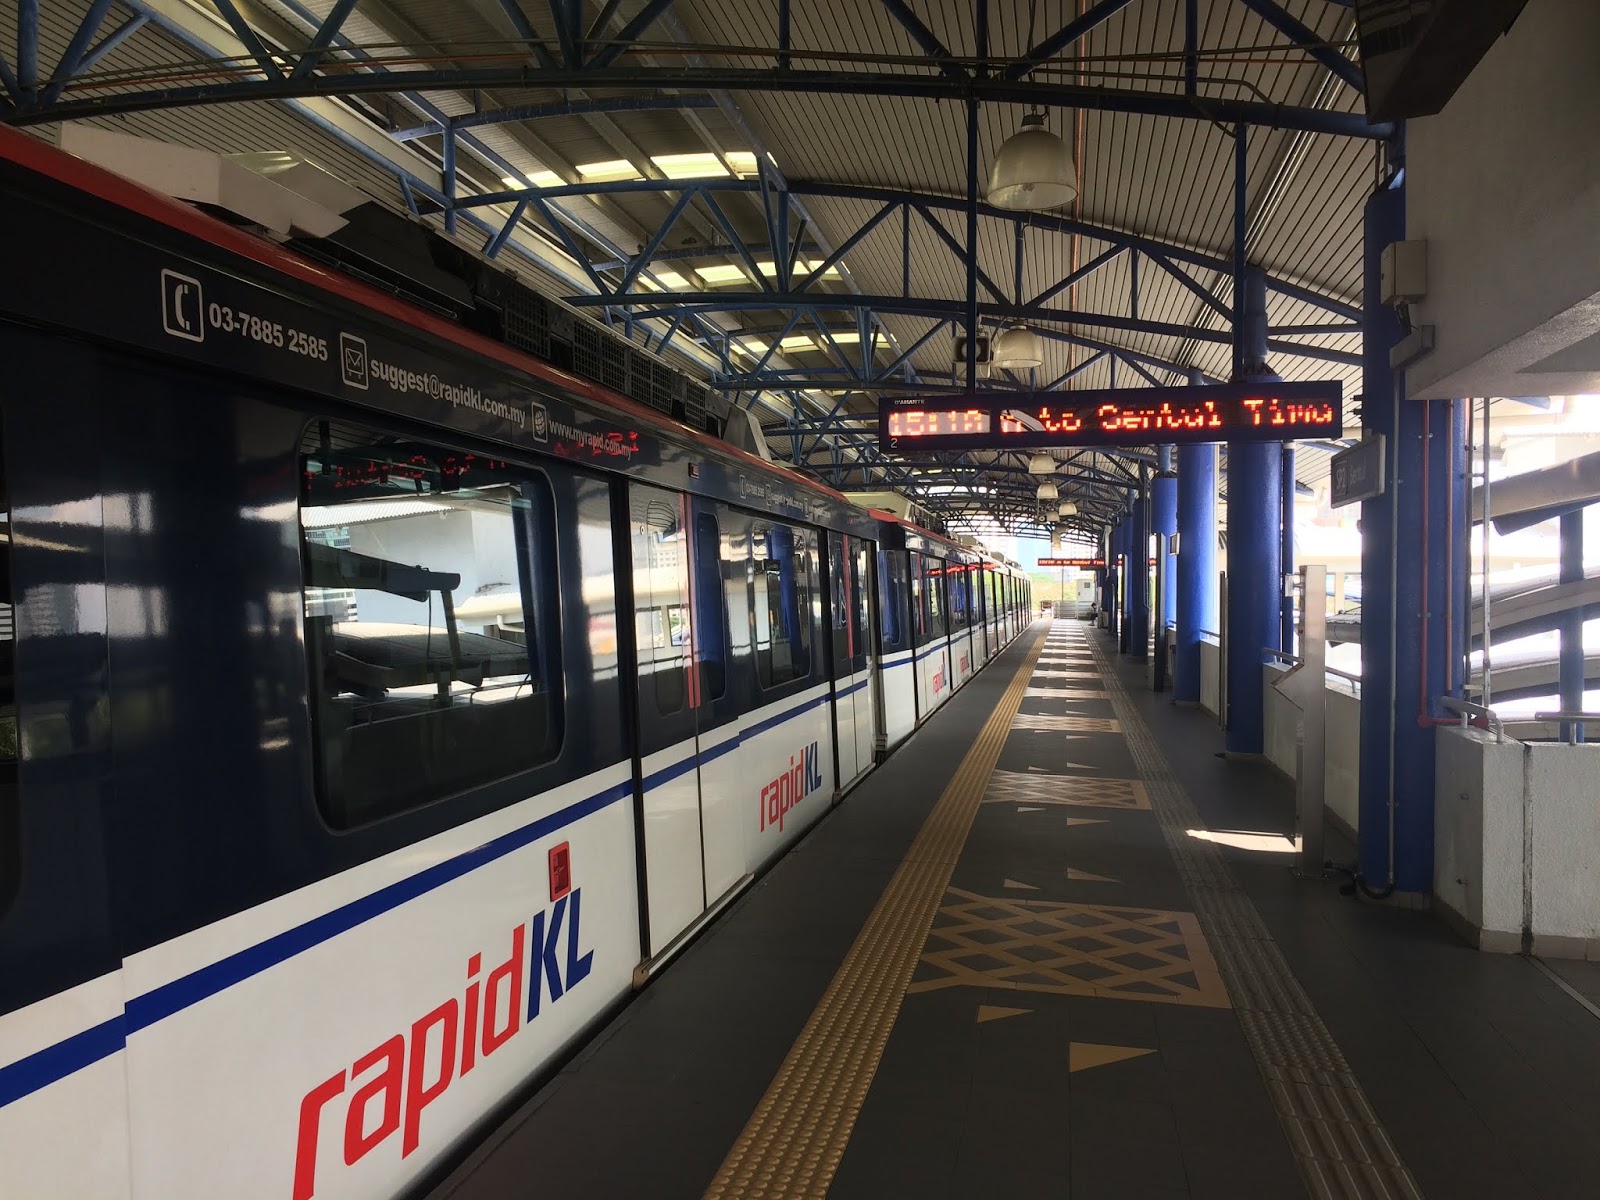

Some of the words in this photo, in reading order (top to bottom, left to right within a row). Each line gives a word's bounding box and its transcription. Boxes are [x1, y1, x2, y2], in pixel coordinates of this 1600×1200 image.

[209, 303, 284, 347] 03-7885
[288, 328, 328, 362] 2585
[371, 359, 526, 429] suggest@rapidkl.com.my
[549, 420, 631, 461] www.myrapid.com.my
[890, 438, 898, 448] 2
[761, 741, 822, 832] rapidKL
[293, 887, 594, 1200] rapidKL
